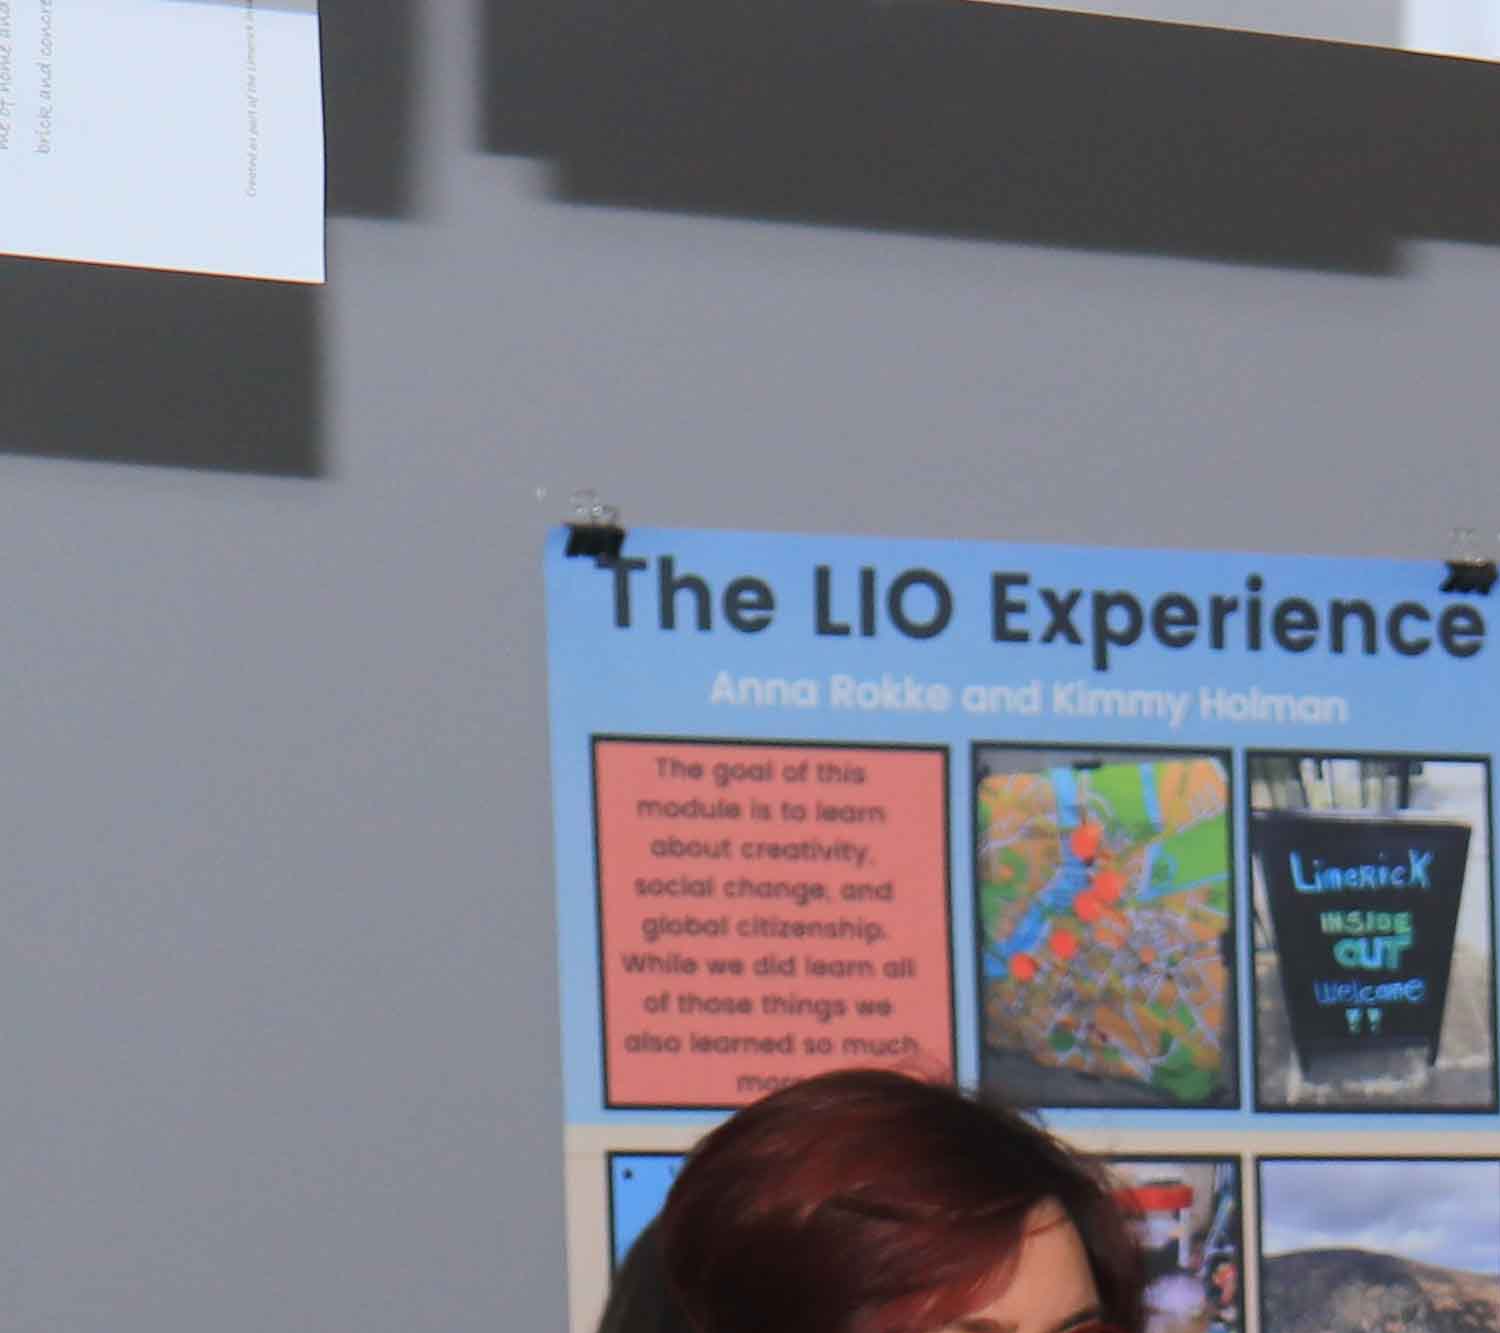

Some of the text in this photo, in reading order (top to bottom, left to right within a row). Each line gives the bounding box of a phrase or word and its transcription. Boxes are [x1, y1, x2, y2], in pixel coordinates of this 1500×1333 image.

[37, 62, 53, 101] and
[35, 102, 53, 154] brick
[602, 555, 1485, 670] The LIO Experience
[710, 670, 1347, 728] Anna Rokke and Kimmy Holman
[656, 758, 865, 787] The goal of this
[637, 799, 885, 823] module is to learn
[651, 838, 873, 867] about creativity,
[635, 877, 893, 906] social change, and
[642, 916, 886, 946] global citizenship.
[621, 953, 916, 978] While we did learn all
[643, 993, 893, 1023] of those things we
[625, 1031, 919, 1056] also learned so much
